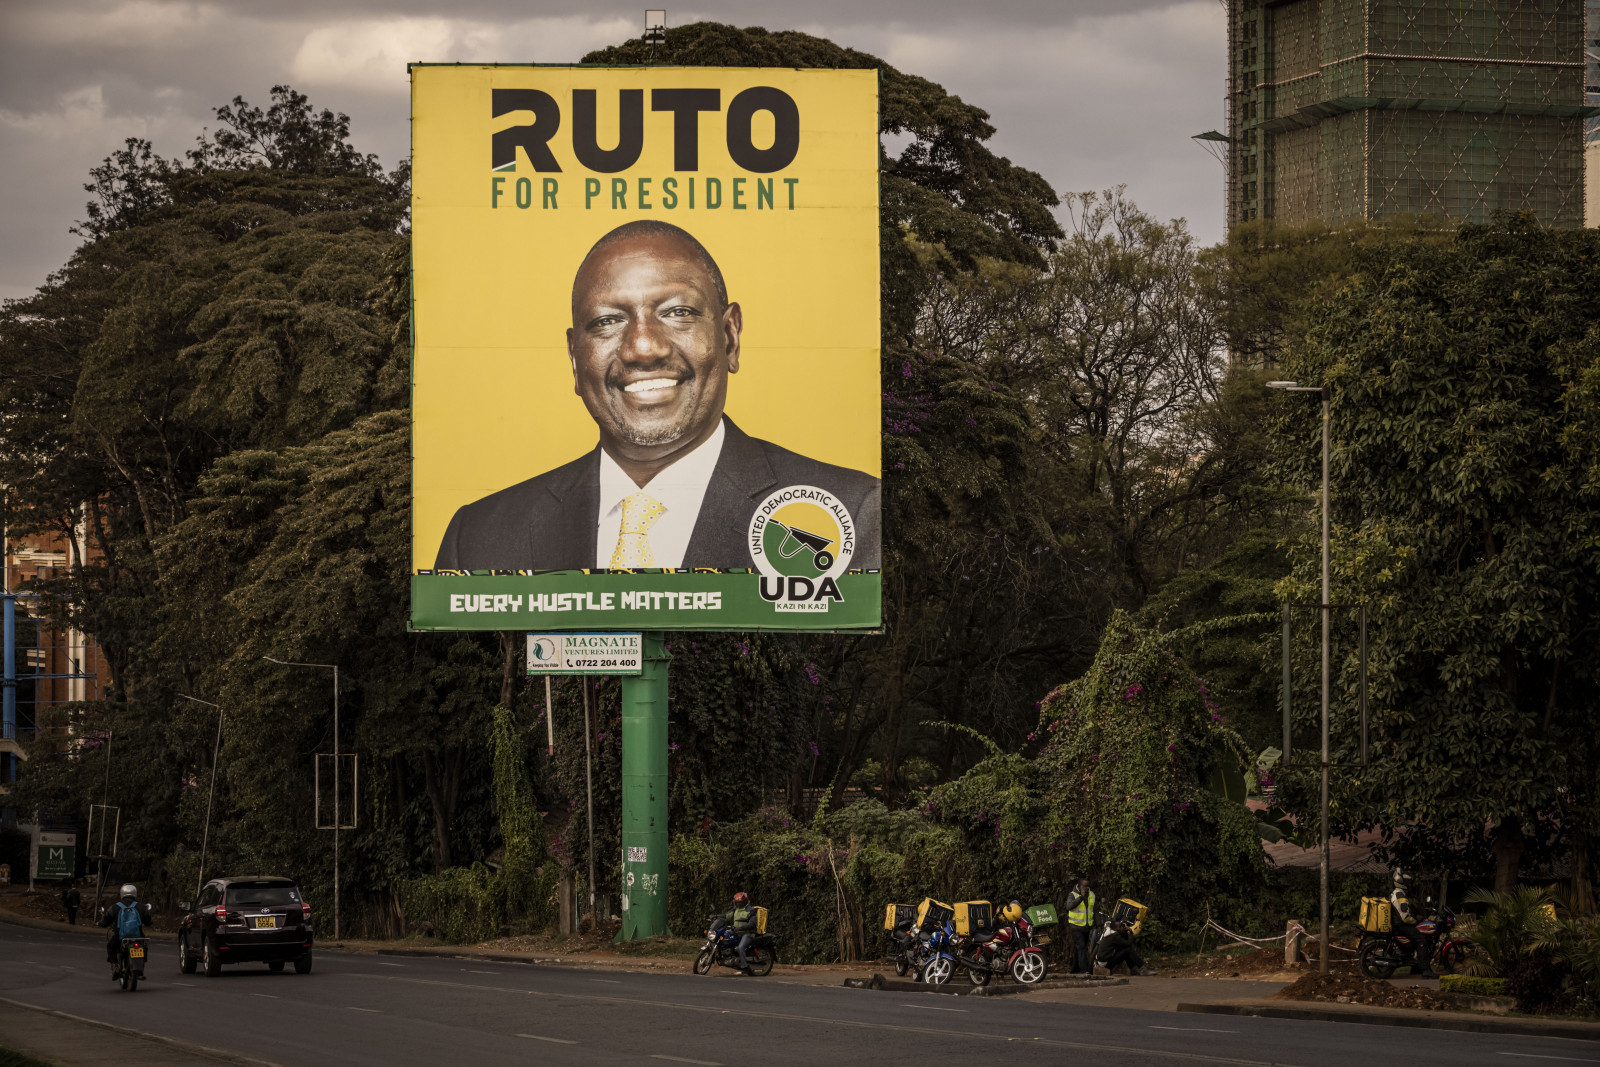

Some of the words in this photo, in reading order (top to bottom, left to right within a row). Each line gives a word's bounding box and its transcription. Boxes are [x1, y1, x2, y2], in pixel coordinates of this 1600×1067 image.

[492, 86, 800, 174] RUTO
[492, 177, 559, 209] FOR
[585, 177, 800, 210] PRESIDENT
[752, 515, 766, 555] UNITED
[762, 489, 831, 515] DEMOCRATIC
[830, 504, 854, 556] ALLIANCE
[760, 576, 843, 602] UDA
[450, 594, 523, 613] EVERY
[528, 592, 616, 612] HUSTLE
[620, 591, 722, 610] MATTERS
[565, 637, 638, 647] MAGNATE
[575, 659, 598, 667] 0722
[600, 659, 617, 667] 204
[619, 659, 637, 667] 400
[49, 847, 64, 860] M
[1037, 915, 1053, 923] Food
